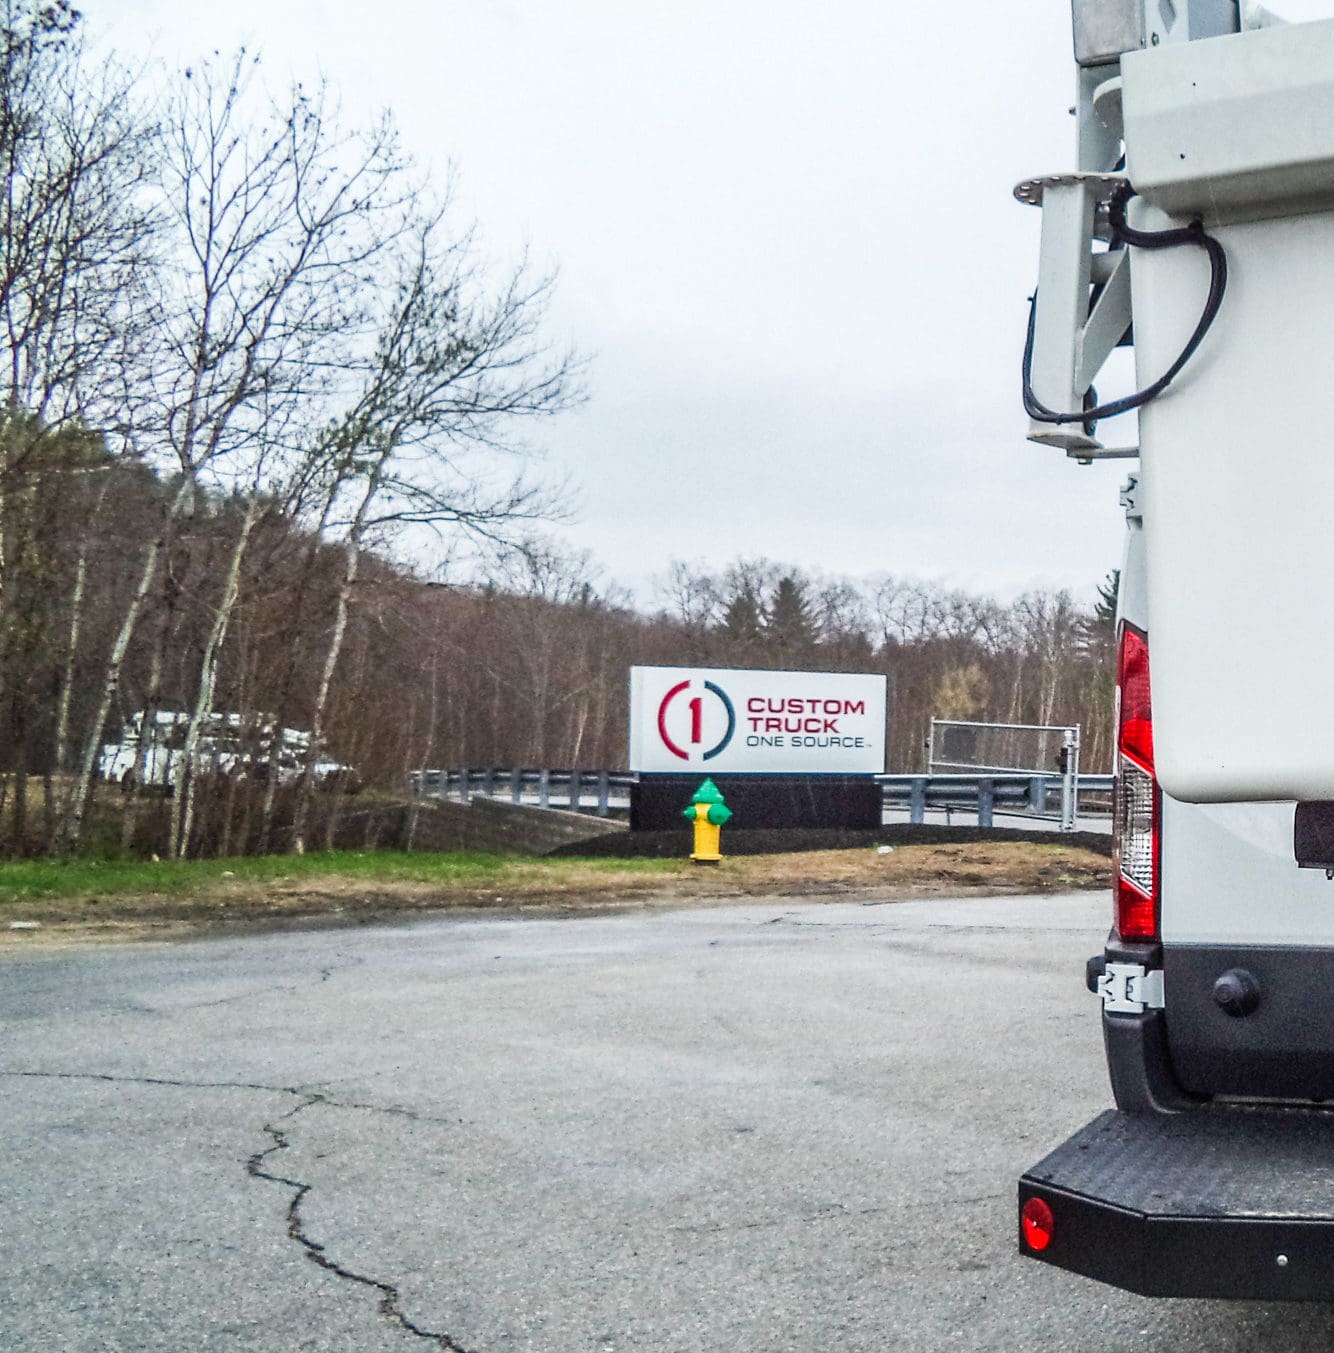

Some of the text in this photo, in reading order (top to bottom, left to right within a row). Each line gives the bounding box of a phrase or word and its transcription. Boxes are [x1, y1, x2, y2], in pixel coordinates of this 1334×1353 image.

[747, 697, 865, 715] CUSTOM
[689, 697, 703, 744] 1
[747, 717, 841, 733] TRUCK
[746, 735, 865, 748] ONE SOURCE
